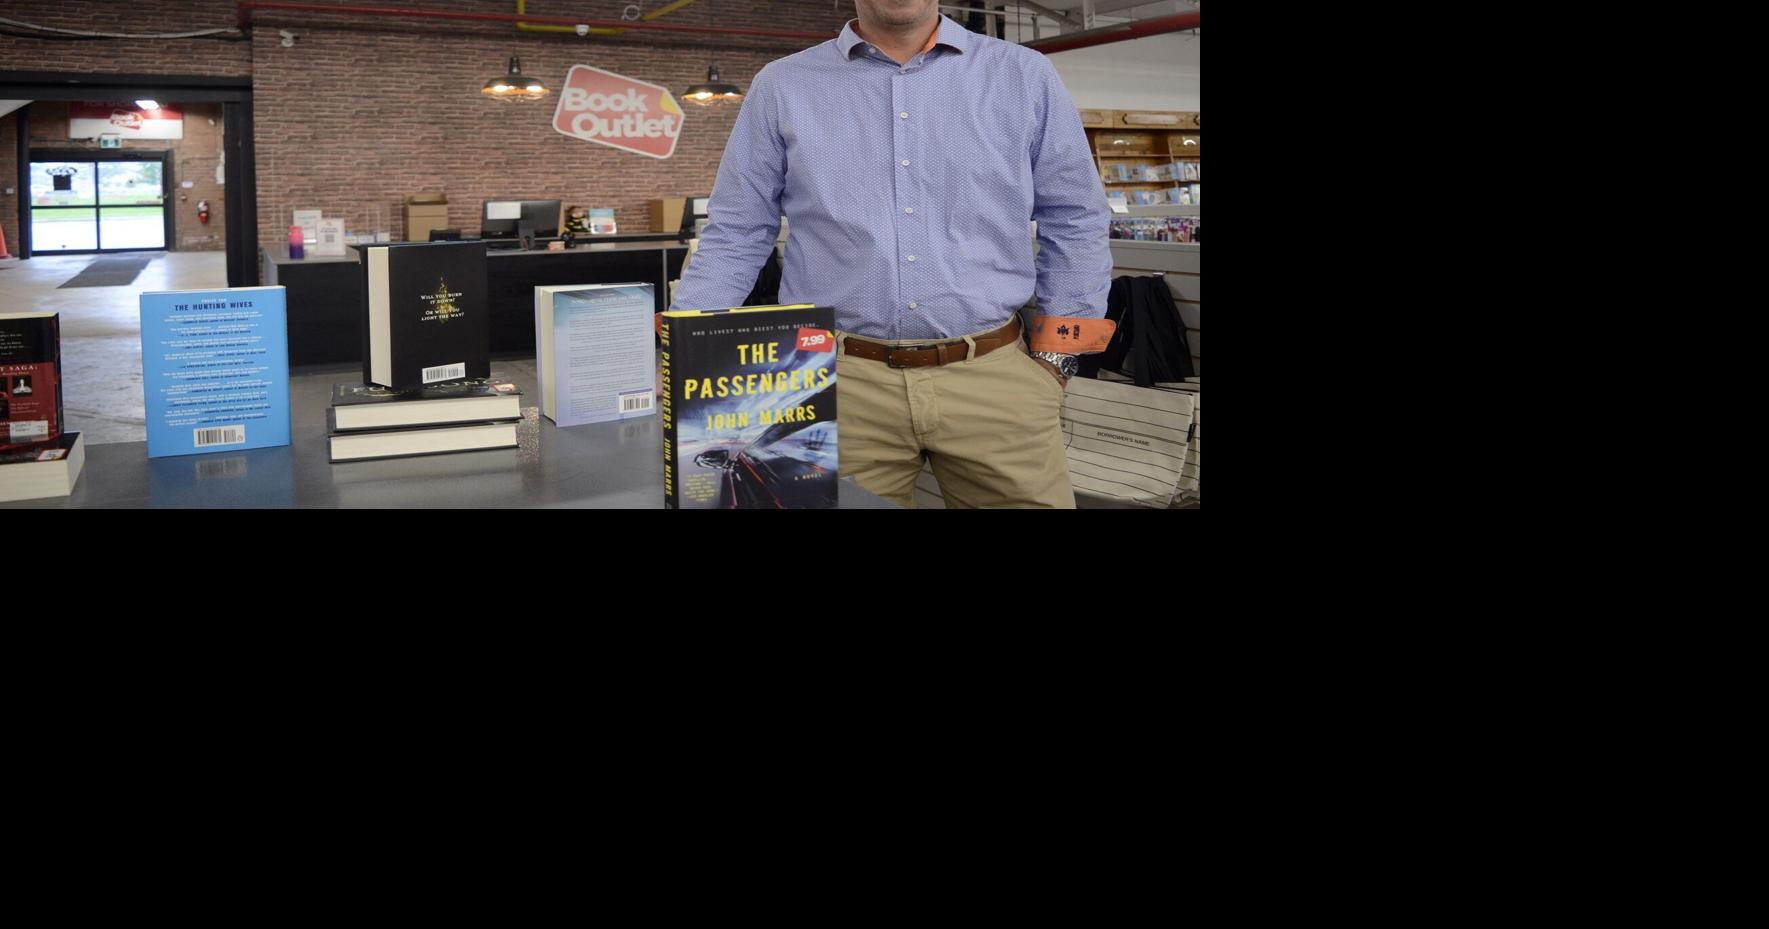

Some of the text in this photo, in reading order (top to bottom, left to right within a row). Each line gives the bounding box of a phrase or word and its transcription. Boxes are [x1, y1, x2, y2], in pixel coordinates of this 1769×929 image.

[564, 88, 648, 112] Book
[571, 112, 677, 138] Outlet
[193, 302, 226, 310] HUNTING
[800, 334, 826, 347] 7.99
[736, 342, 780, 365] THE
[684, 368, 830, 400] PASSENGERS
[662, 323, 673, 496] THE PASSENGERS JOHN MARRS
[706, 404, 816, 432] JOHN MARRS
[1097, 431, 1151, 446] BORROWER'S NAME
